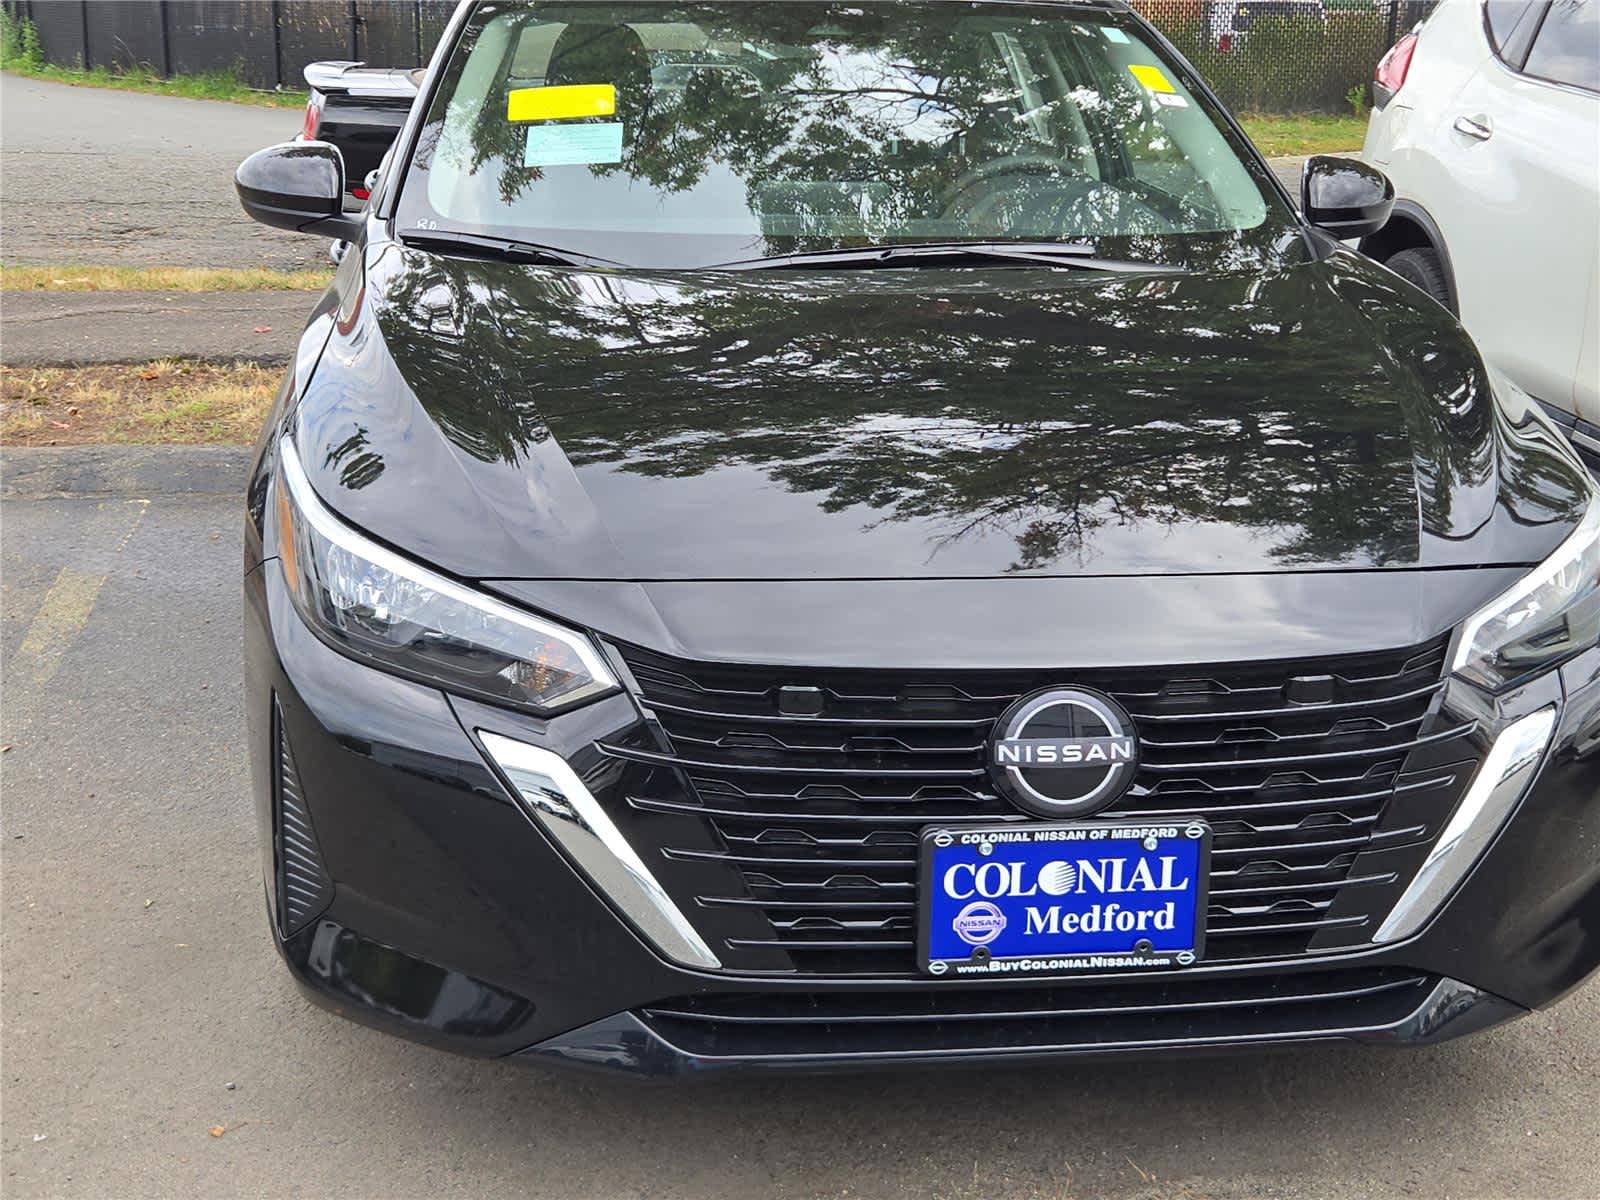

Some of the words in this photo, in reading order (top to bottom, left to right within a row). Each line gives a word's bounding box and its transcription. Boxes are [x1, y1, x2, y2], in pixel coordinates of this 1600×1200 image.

[998, 741, 1131, 763] NISSAN
[961, 832, 1031, 844] COLONIAL
[1035, 831, 1086, 842] NISSAN
[1090, 830, 1108, 840] OF
[1112, 828, 1178, 839] MEDFORD
[943, 856, 1189, 900] COLONIAL
[959, 919, 1001, 928] NISSAN
[1023, 902, 1176, 935] Medford
